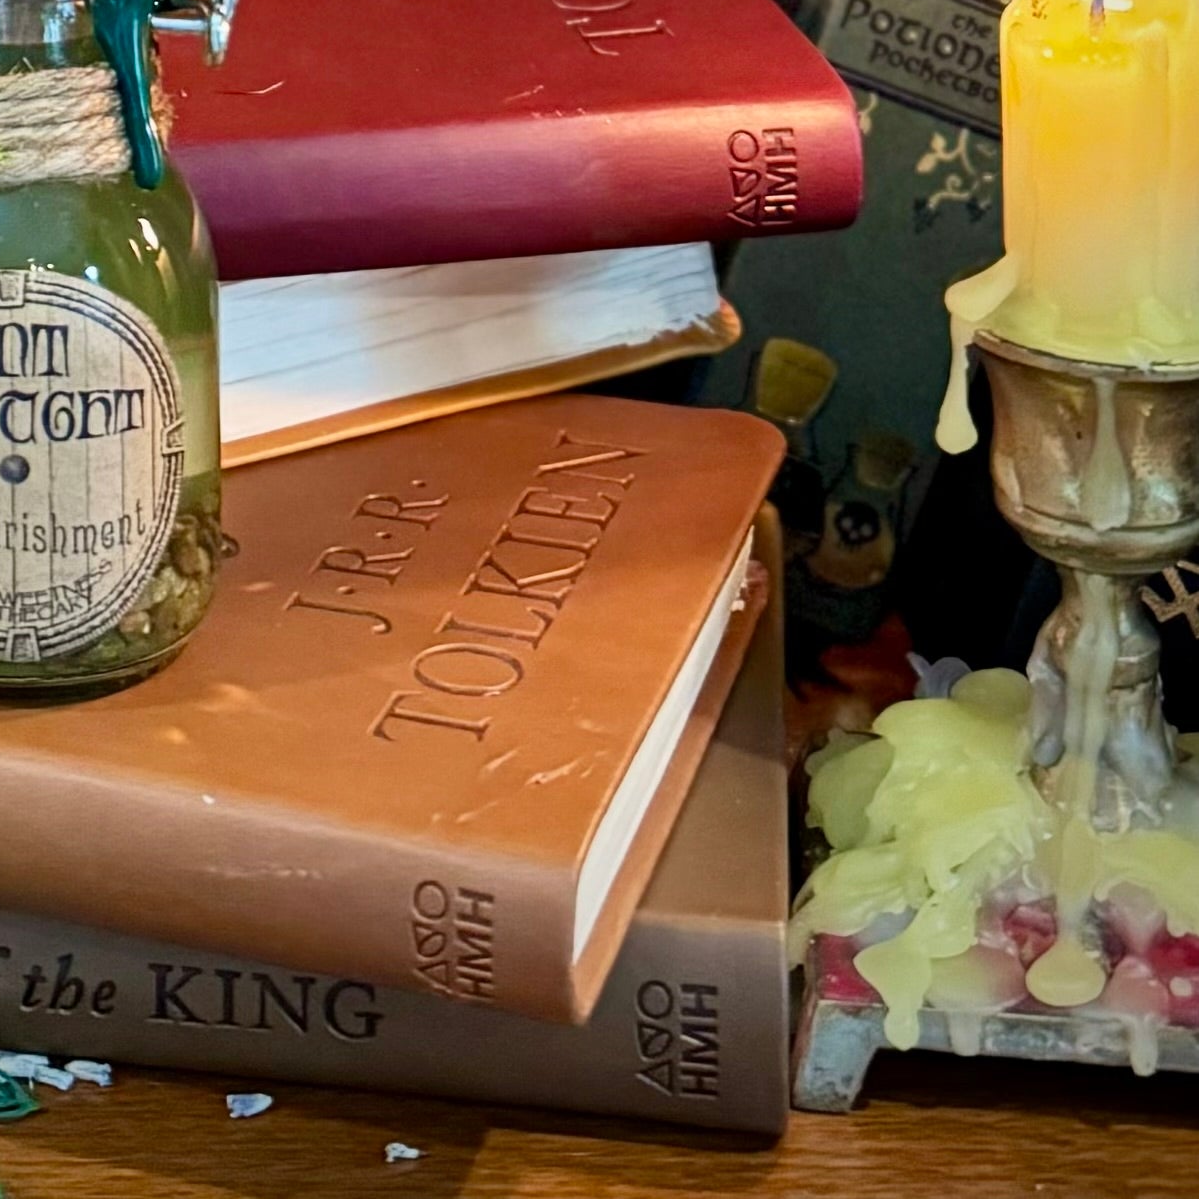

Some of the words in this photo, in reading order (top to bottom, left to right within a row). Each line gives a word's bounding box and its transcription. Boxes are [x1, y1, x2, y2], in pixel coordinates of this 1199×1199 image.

[367, 429, 652, 743] TOLKIEN
[21, 954, 117, 1015] the
[147, 963, 386, 1041] KING
